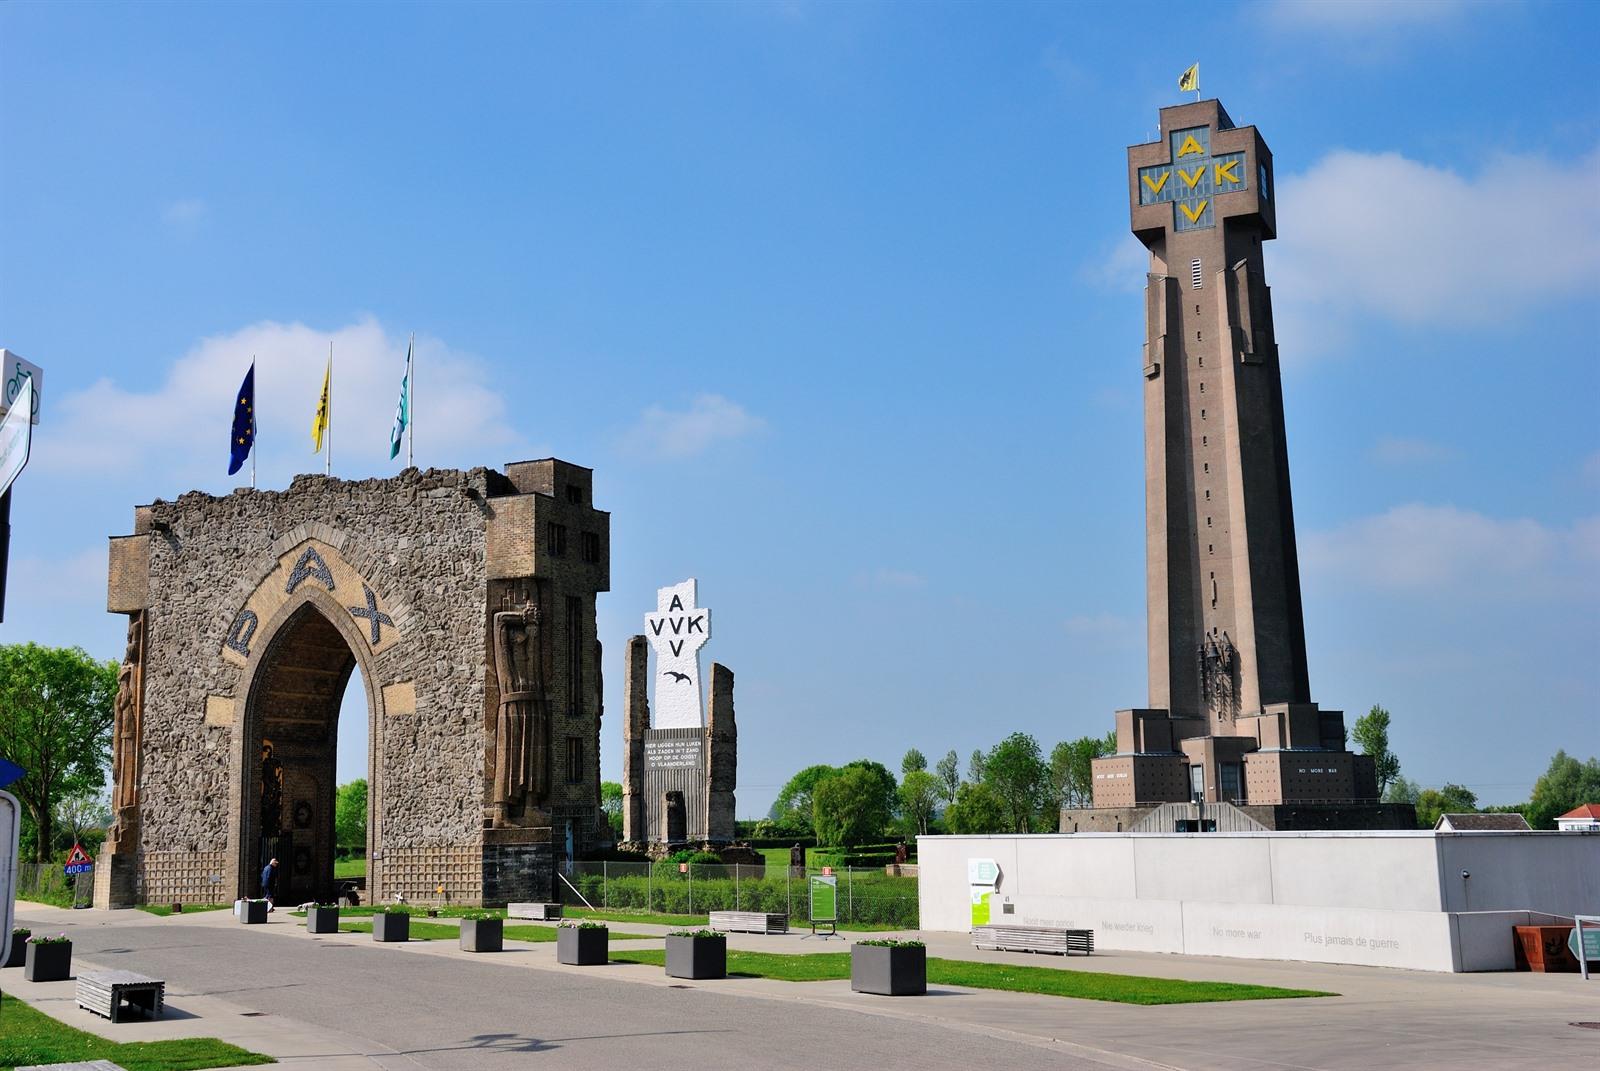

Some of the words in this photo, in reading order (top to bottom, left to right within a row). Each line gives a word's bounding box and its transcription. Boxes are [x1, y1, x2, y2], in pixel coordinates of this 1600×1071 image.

[1177, 134, 1204, 158] A
[1179, 200, 1208, 224] V
[668, 594, 684, 612] A
[669, 639, 684, 658] V
[66, 864, 82, 874] 400
[1212, 926, 1224, 936] No
[1225, 928, 1246, 938] more
[1246, 930, 1262, 939] war
[1304, 932, 1323, 944] Plus
[1324, 933, 1354, 948] jamais
[1355, 936, 1367, 947] de
[1369, 938, 1400, 951] guerre
